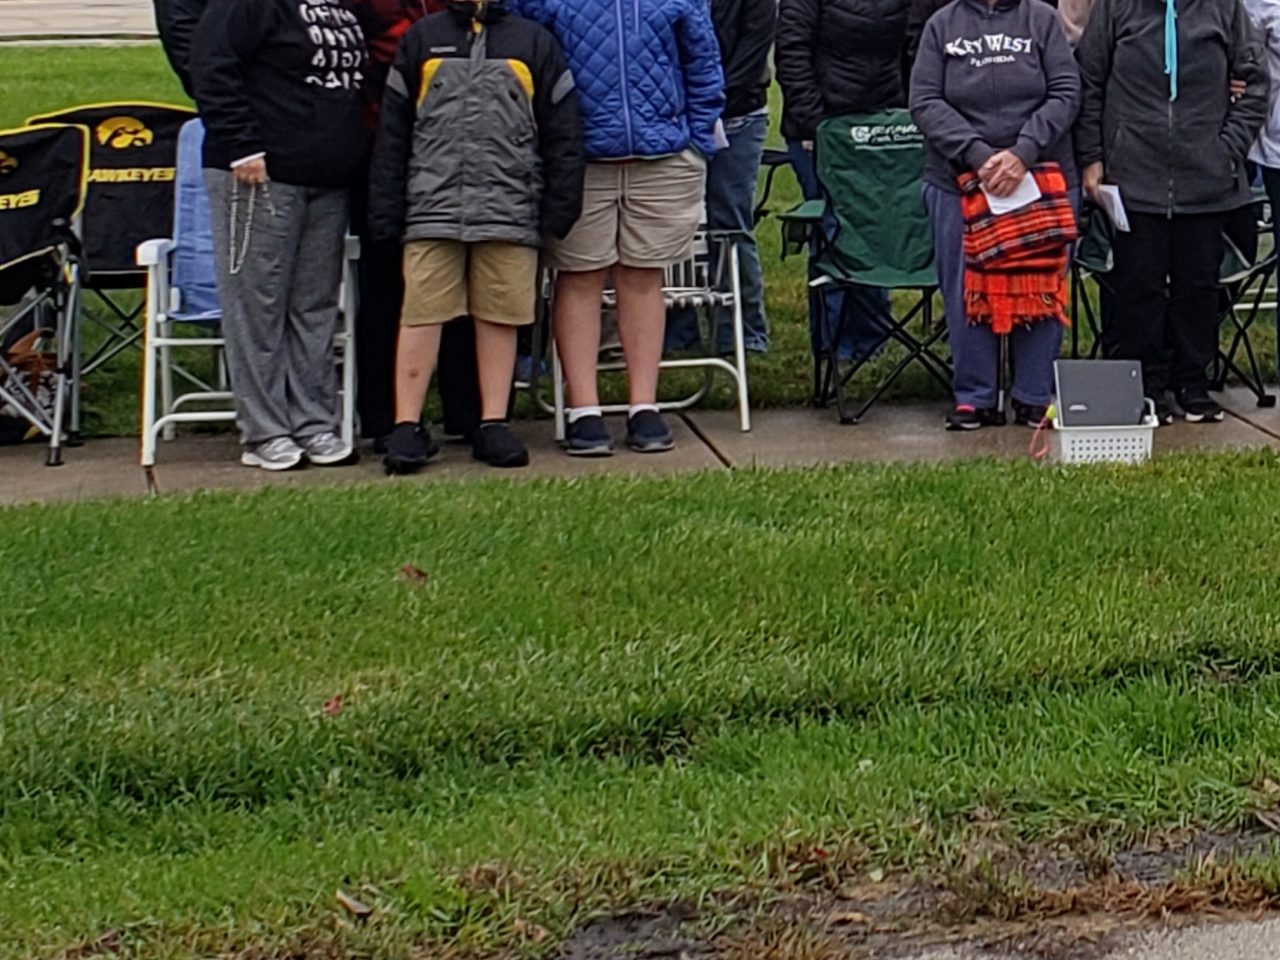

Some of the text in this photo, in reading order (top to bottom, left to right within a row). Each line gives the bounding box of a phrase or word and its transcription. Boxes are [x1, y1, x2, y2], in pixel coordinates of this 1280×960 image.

[945, 33, 1032, 56] KEY WEST
[87, 168, 177, 182] AWKEYES
